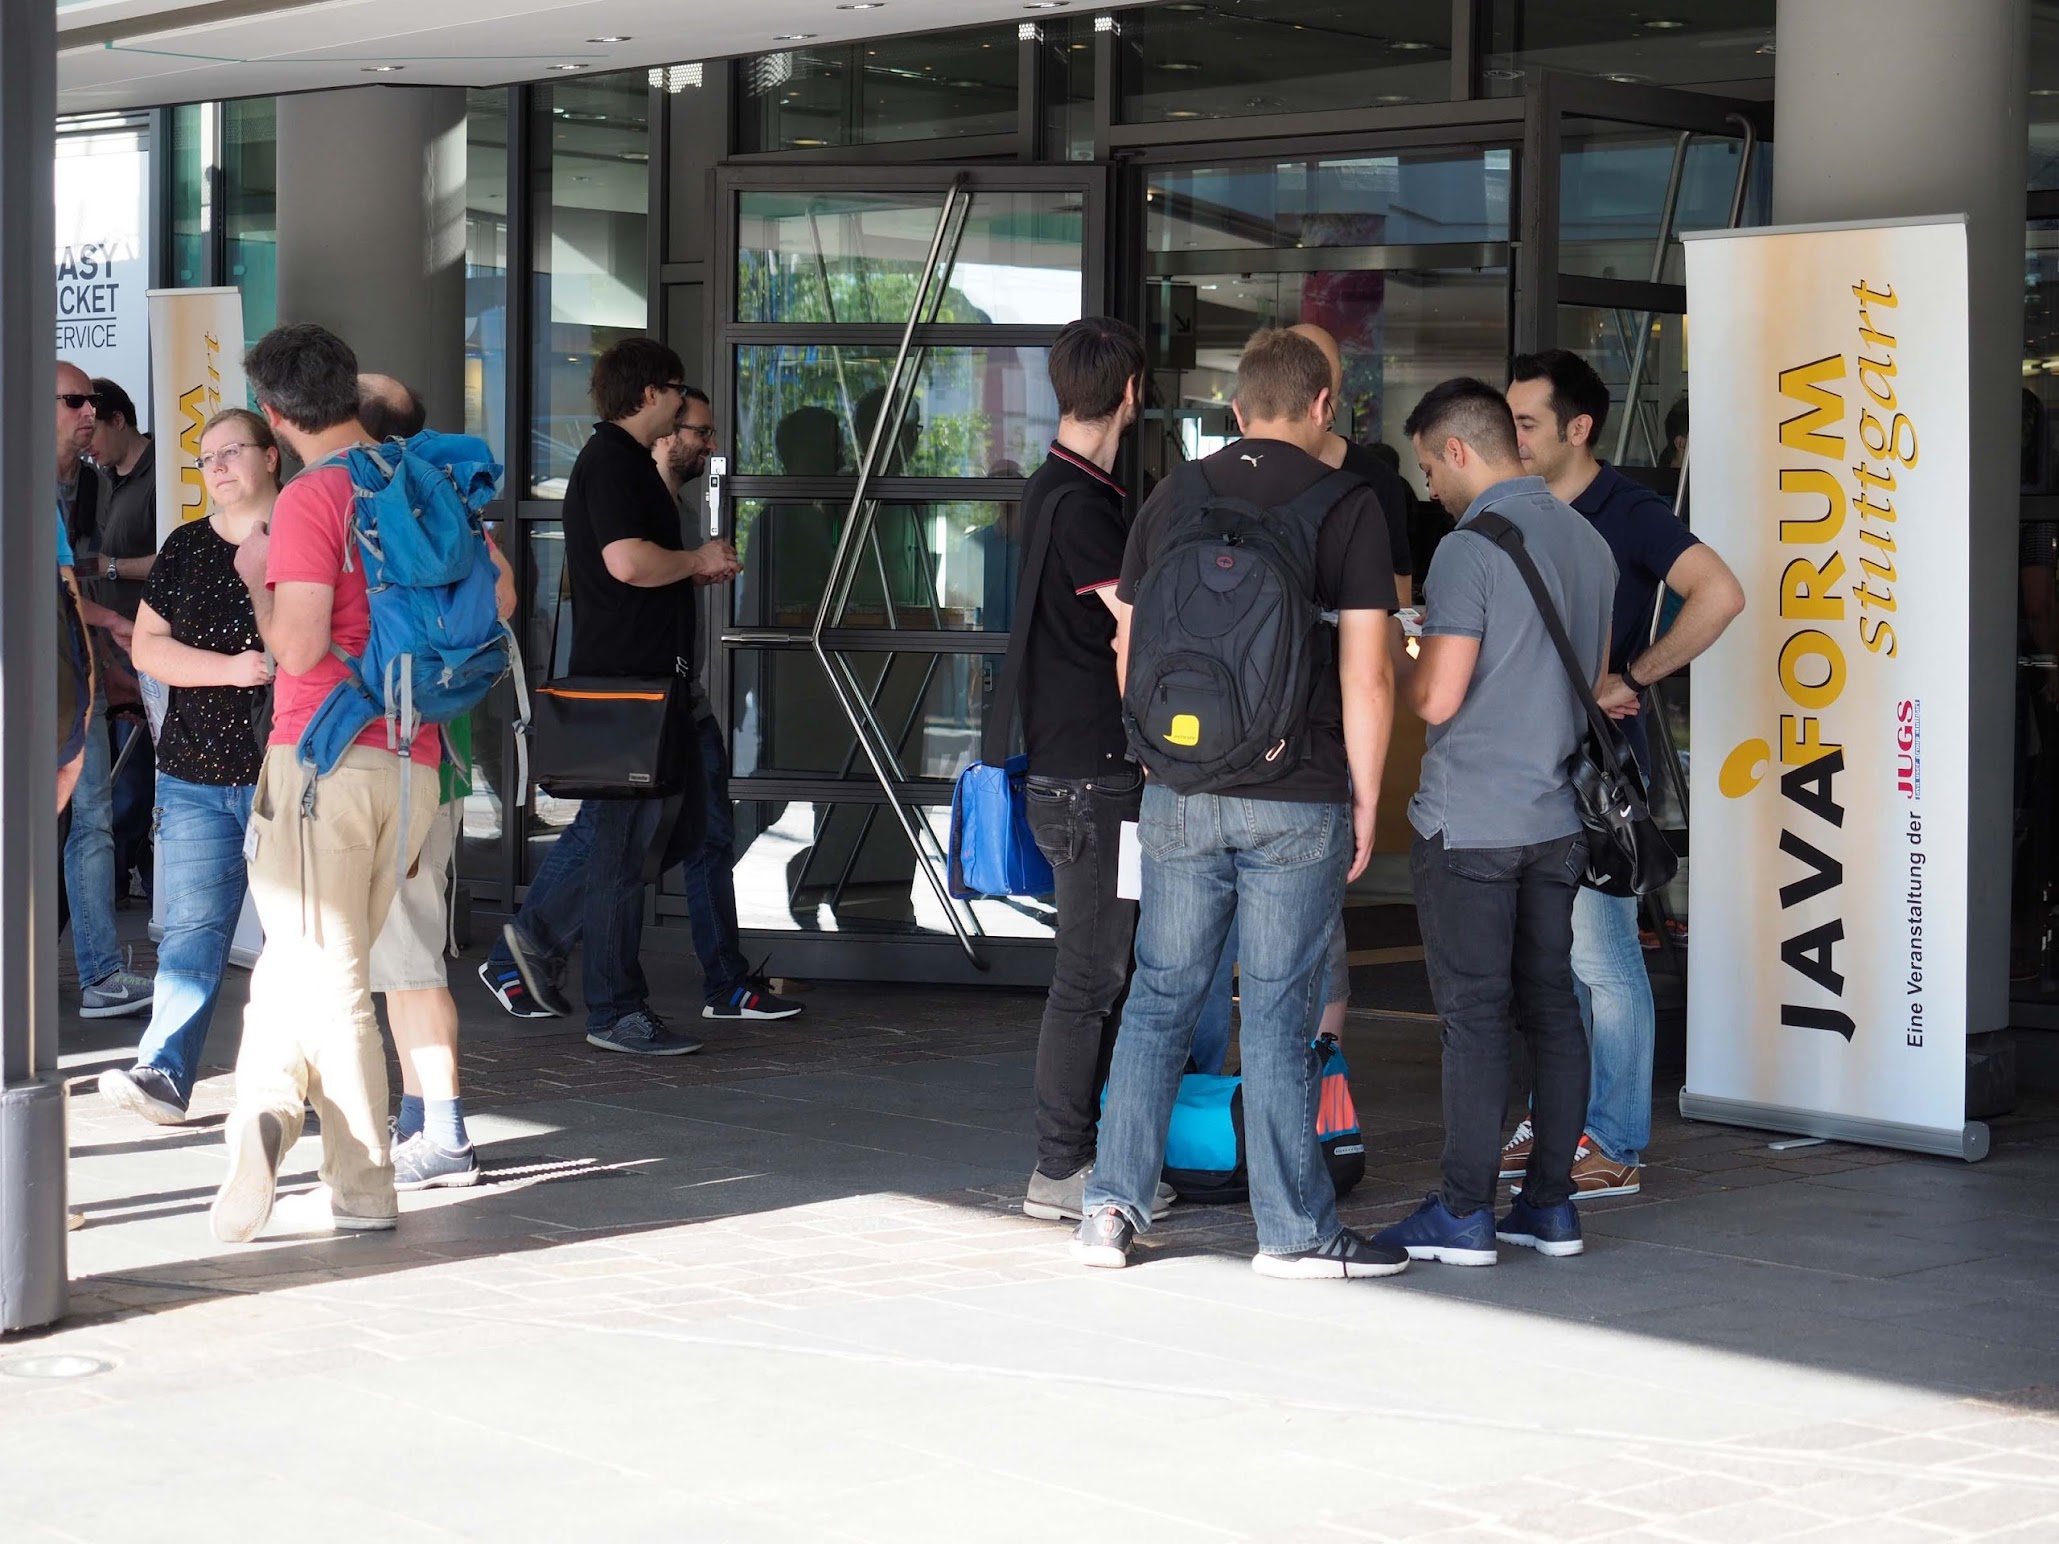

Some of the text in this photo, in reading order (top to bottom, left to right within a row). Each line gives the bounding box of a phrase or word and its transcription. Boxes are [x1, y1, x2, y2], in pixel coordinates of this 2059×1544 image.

[57, 243, 118, 281] ASY
[56, 283, 119, 315] CKET
[56, 324, 117, 349] ERVICE
[1852, 279, 1919, 659] stuttgart
[1897, 700, 1914, 800] JUGS
[1906, 810, 1926, 1048] Eine Veranstaltung der
